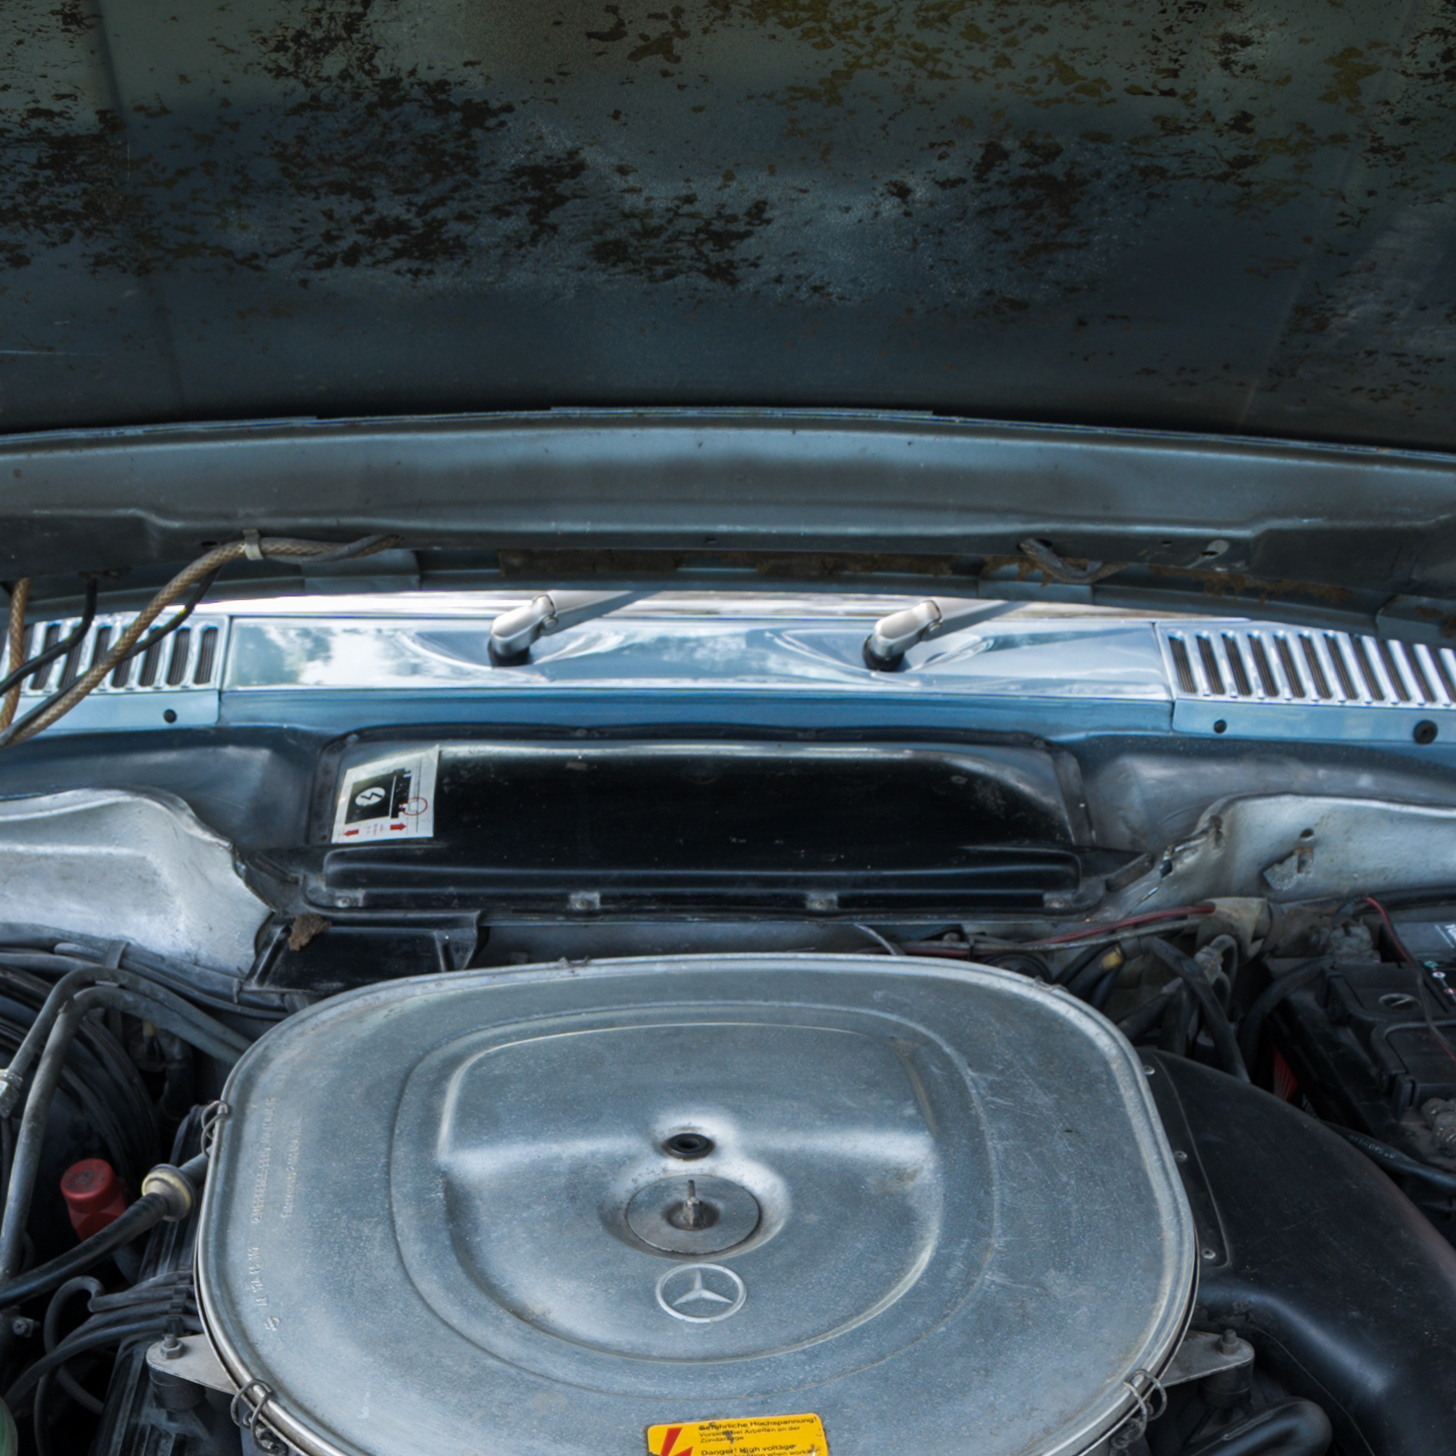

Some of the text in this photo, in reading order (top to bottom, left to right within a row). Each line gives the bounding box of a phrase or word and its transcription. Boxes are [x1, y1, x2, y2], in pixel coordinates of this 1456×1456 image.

[749, 1416, 817, 1428] Hochspannung!
[701, 1448, 737, 1456] Danger!
[761, 1444, 796, 1452] voltage
